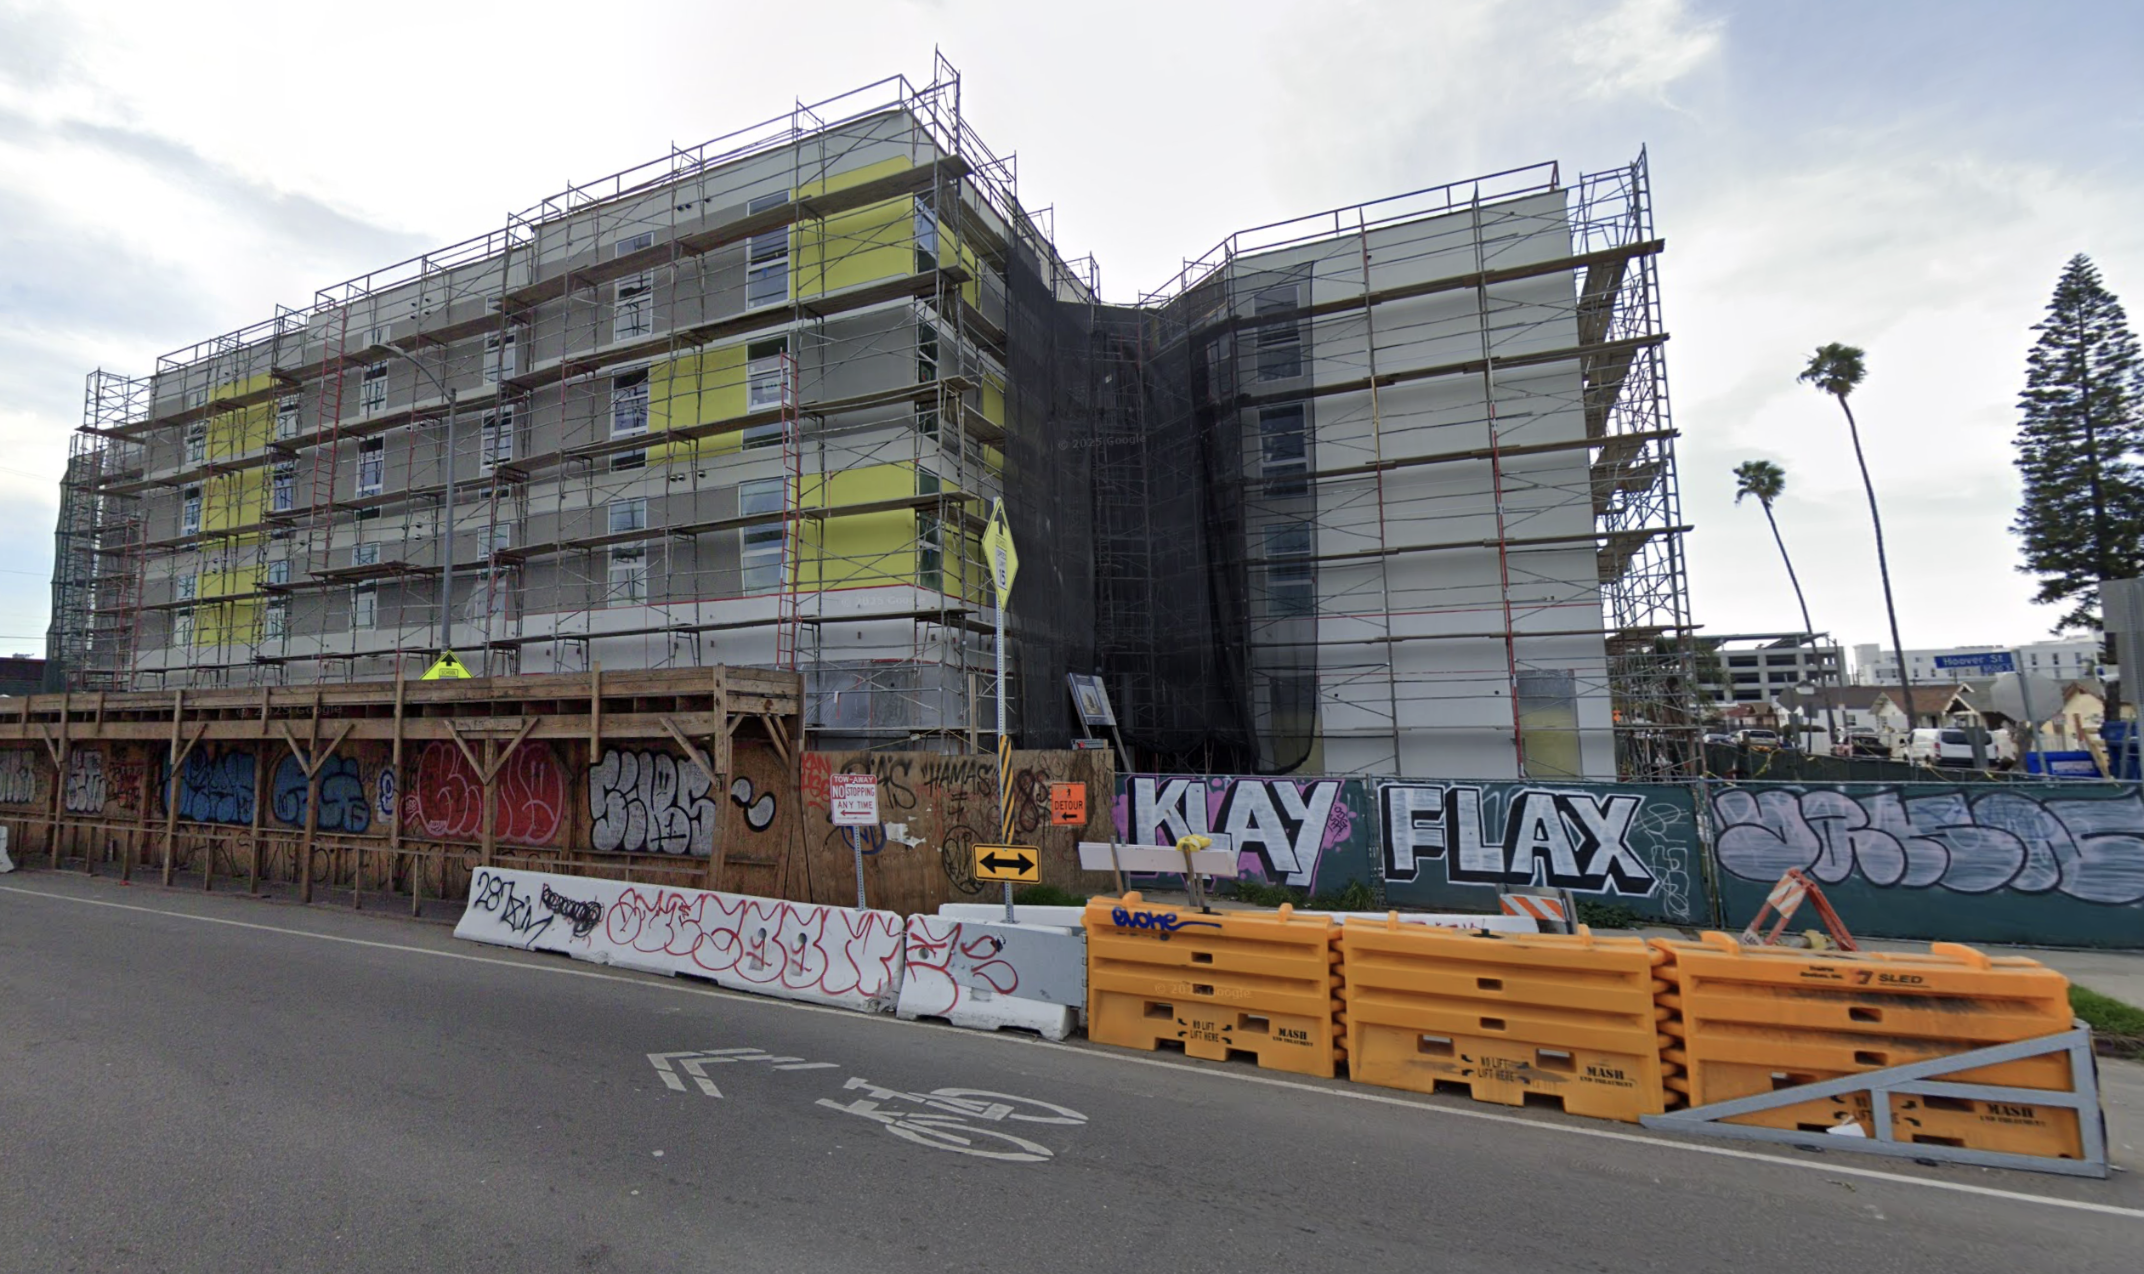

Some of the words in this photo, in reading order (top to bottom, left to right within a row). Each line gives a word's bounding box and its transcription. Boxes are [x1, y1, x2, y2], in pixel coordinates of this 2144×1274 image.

[1943, 656, 1985, 666] Hoover
[1989, 654, 2004, 663] St
[832, 785, 845, 798] NO
[847, 787, 875, 797] STOPPING
[837, 800, 854, 810] ANY
[857, 800, 874, 810] TIME
[1054, 800, 1083, 811] DETOUR
[1128, 775, 1343, 890] KLAY
[1378, 784, 1659, 896] FLAX
[1878, 973, 1924, 984] SLED
[1201, 1021, 1215, 1031] LIFT
[1190, 1030, 1202, 1039] LIFT
[1204, 1032, 1219, 1043] HERE
[1278, 1028, 1307, 1040] MASH
[1477, 1068, 1493, 1080] LIFT
[1495, 1069, 1514, 1082] HERE
[1586, 1066, 1625, 1080] MASH
[1987, 1104, 2036, 1119] MASH
